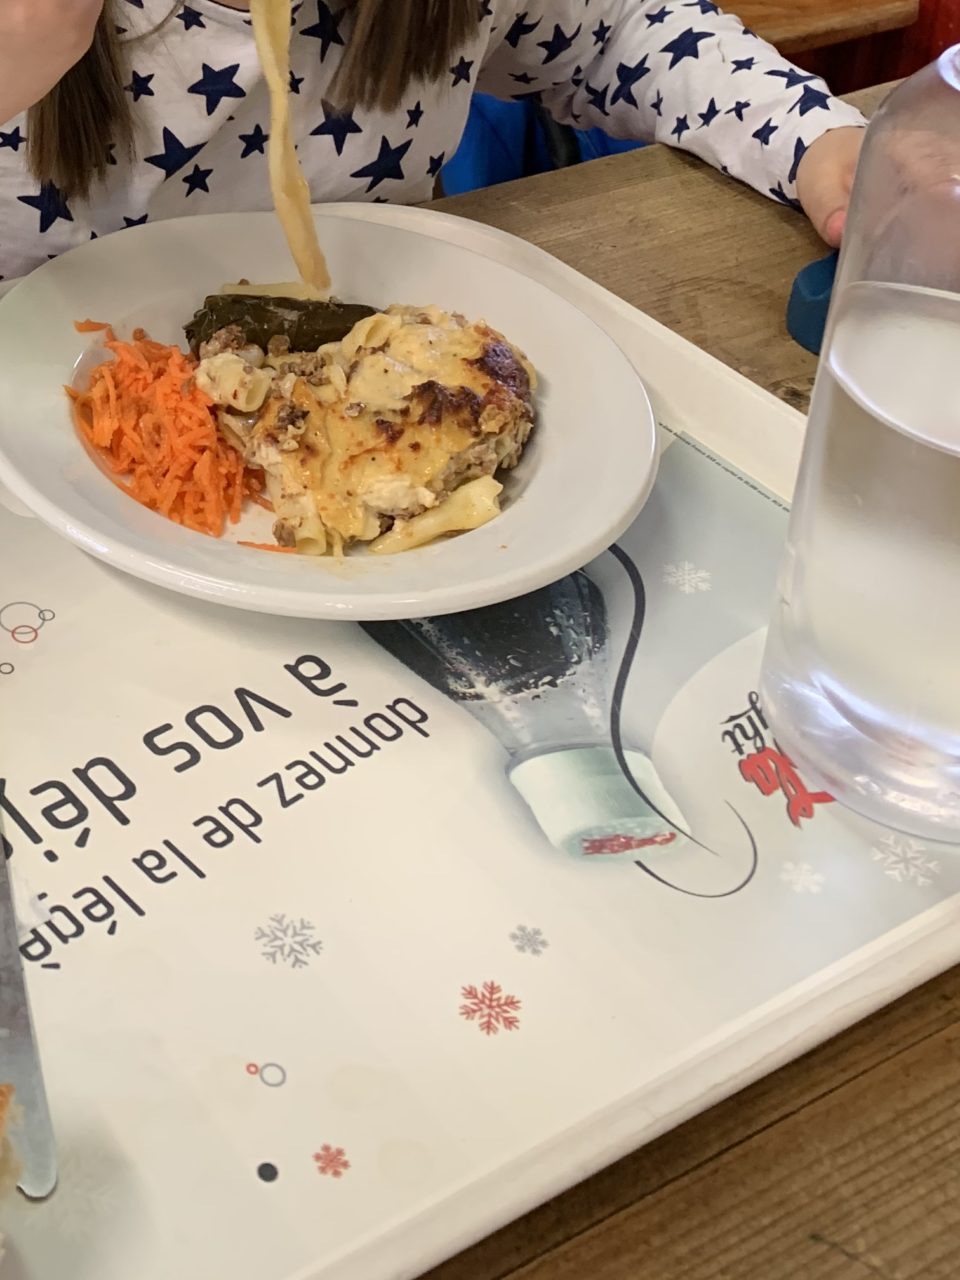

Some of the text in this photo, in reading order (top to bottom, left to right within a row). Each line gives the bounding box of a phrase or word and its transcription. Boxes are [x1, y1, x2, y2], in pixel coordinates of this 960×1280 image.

[283, 653, 359, 708] à
[142, 686, 293, 774] vos
[256, 695, 431, 809] donnez
[192, 797, 264, 849] de
[132, 839, 207, 885] la
